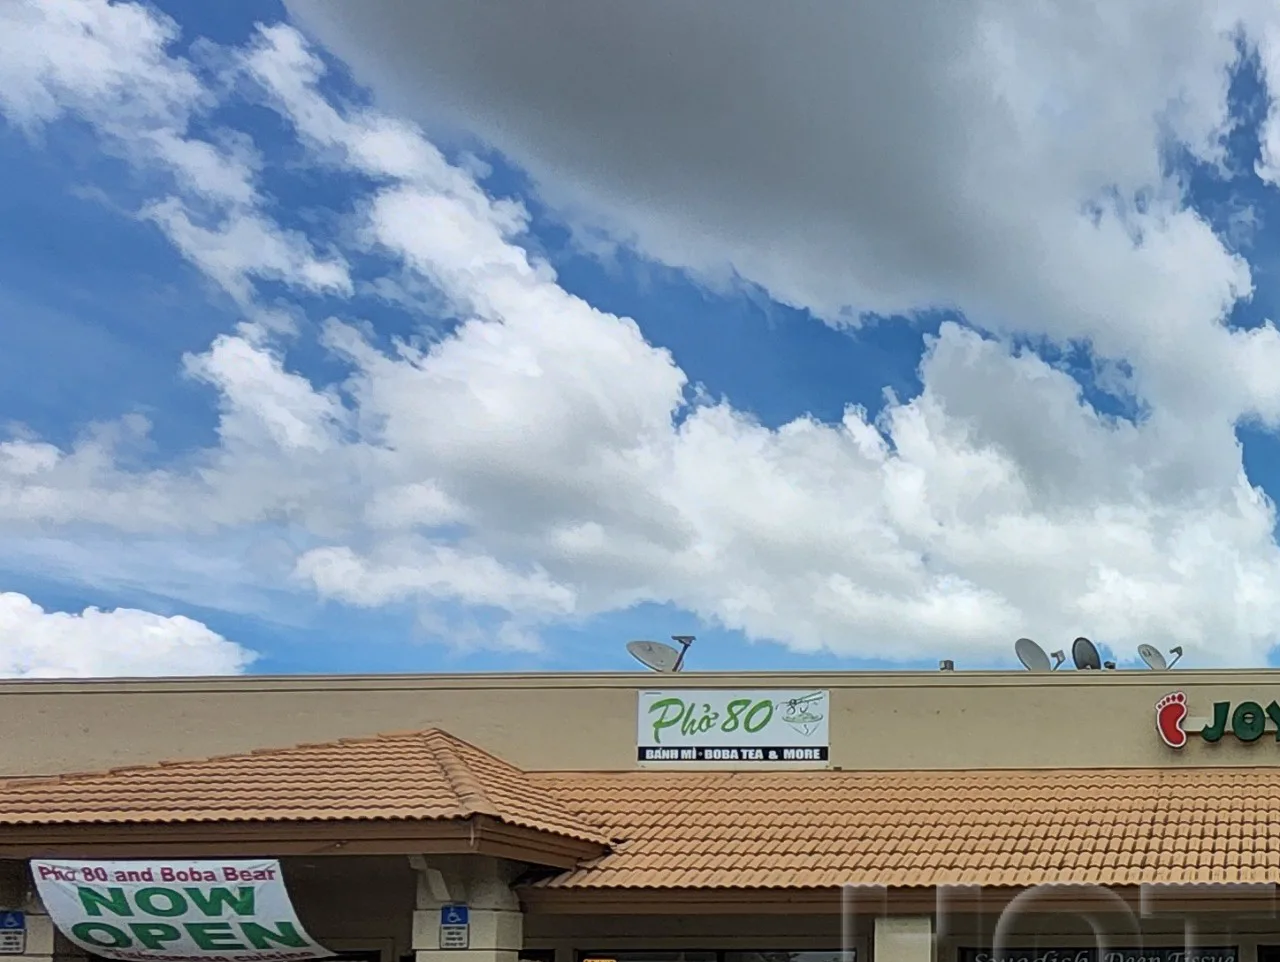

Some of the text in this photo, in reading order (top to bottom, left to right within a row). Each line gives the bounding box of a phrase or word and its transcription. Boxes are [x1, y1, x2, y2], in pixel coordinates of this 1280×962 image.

[721, 699, 774, 733] 80
[704, 748, 739, 760] BOBA
[740, 748, 764, 760] TEA
[767, 750, 778, 760] &
[783, 748, 821, 760] MORE
[82, 866, 109, 882] 80
[115, 867, 154, 882] and
[159, 866, 216, 882] Boba
[223, 867, 277, 882] Bear
[78, 886, 255, 917] NOW
[71, 921, 311, 951] OPEN
